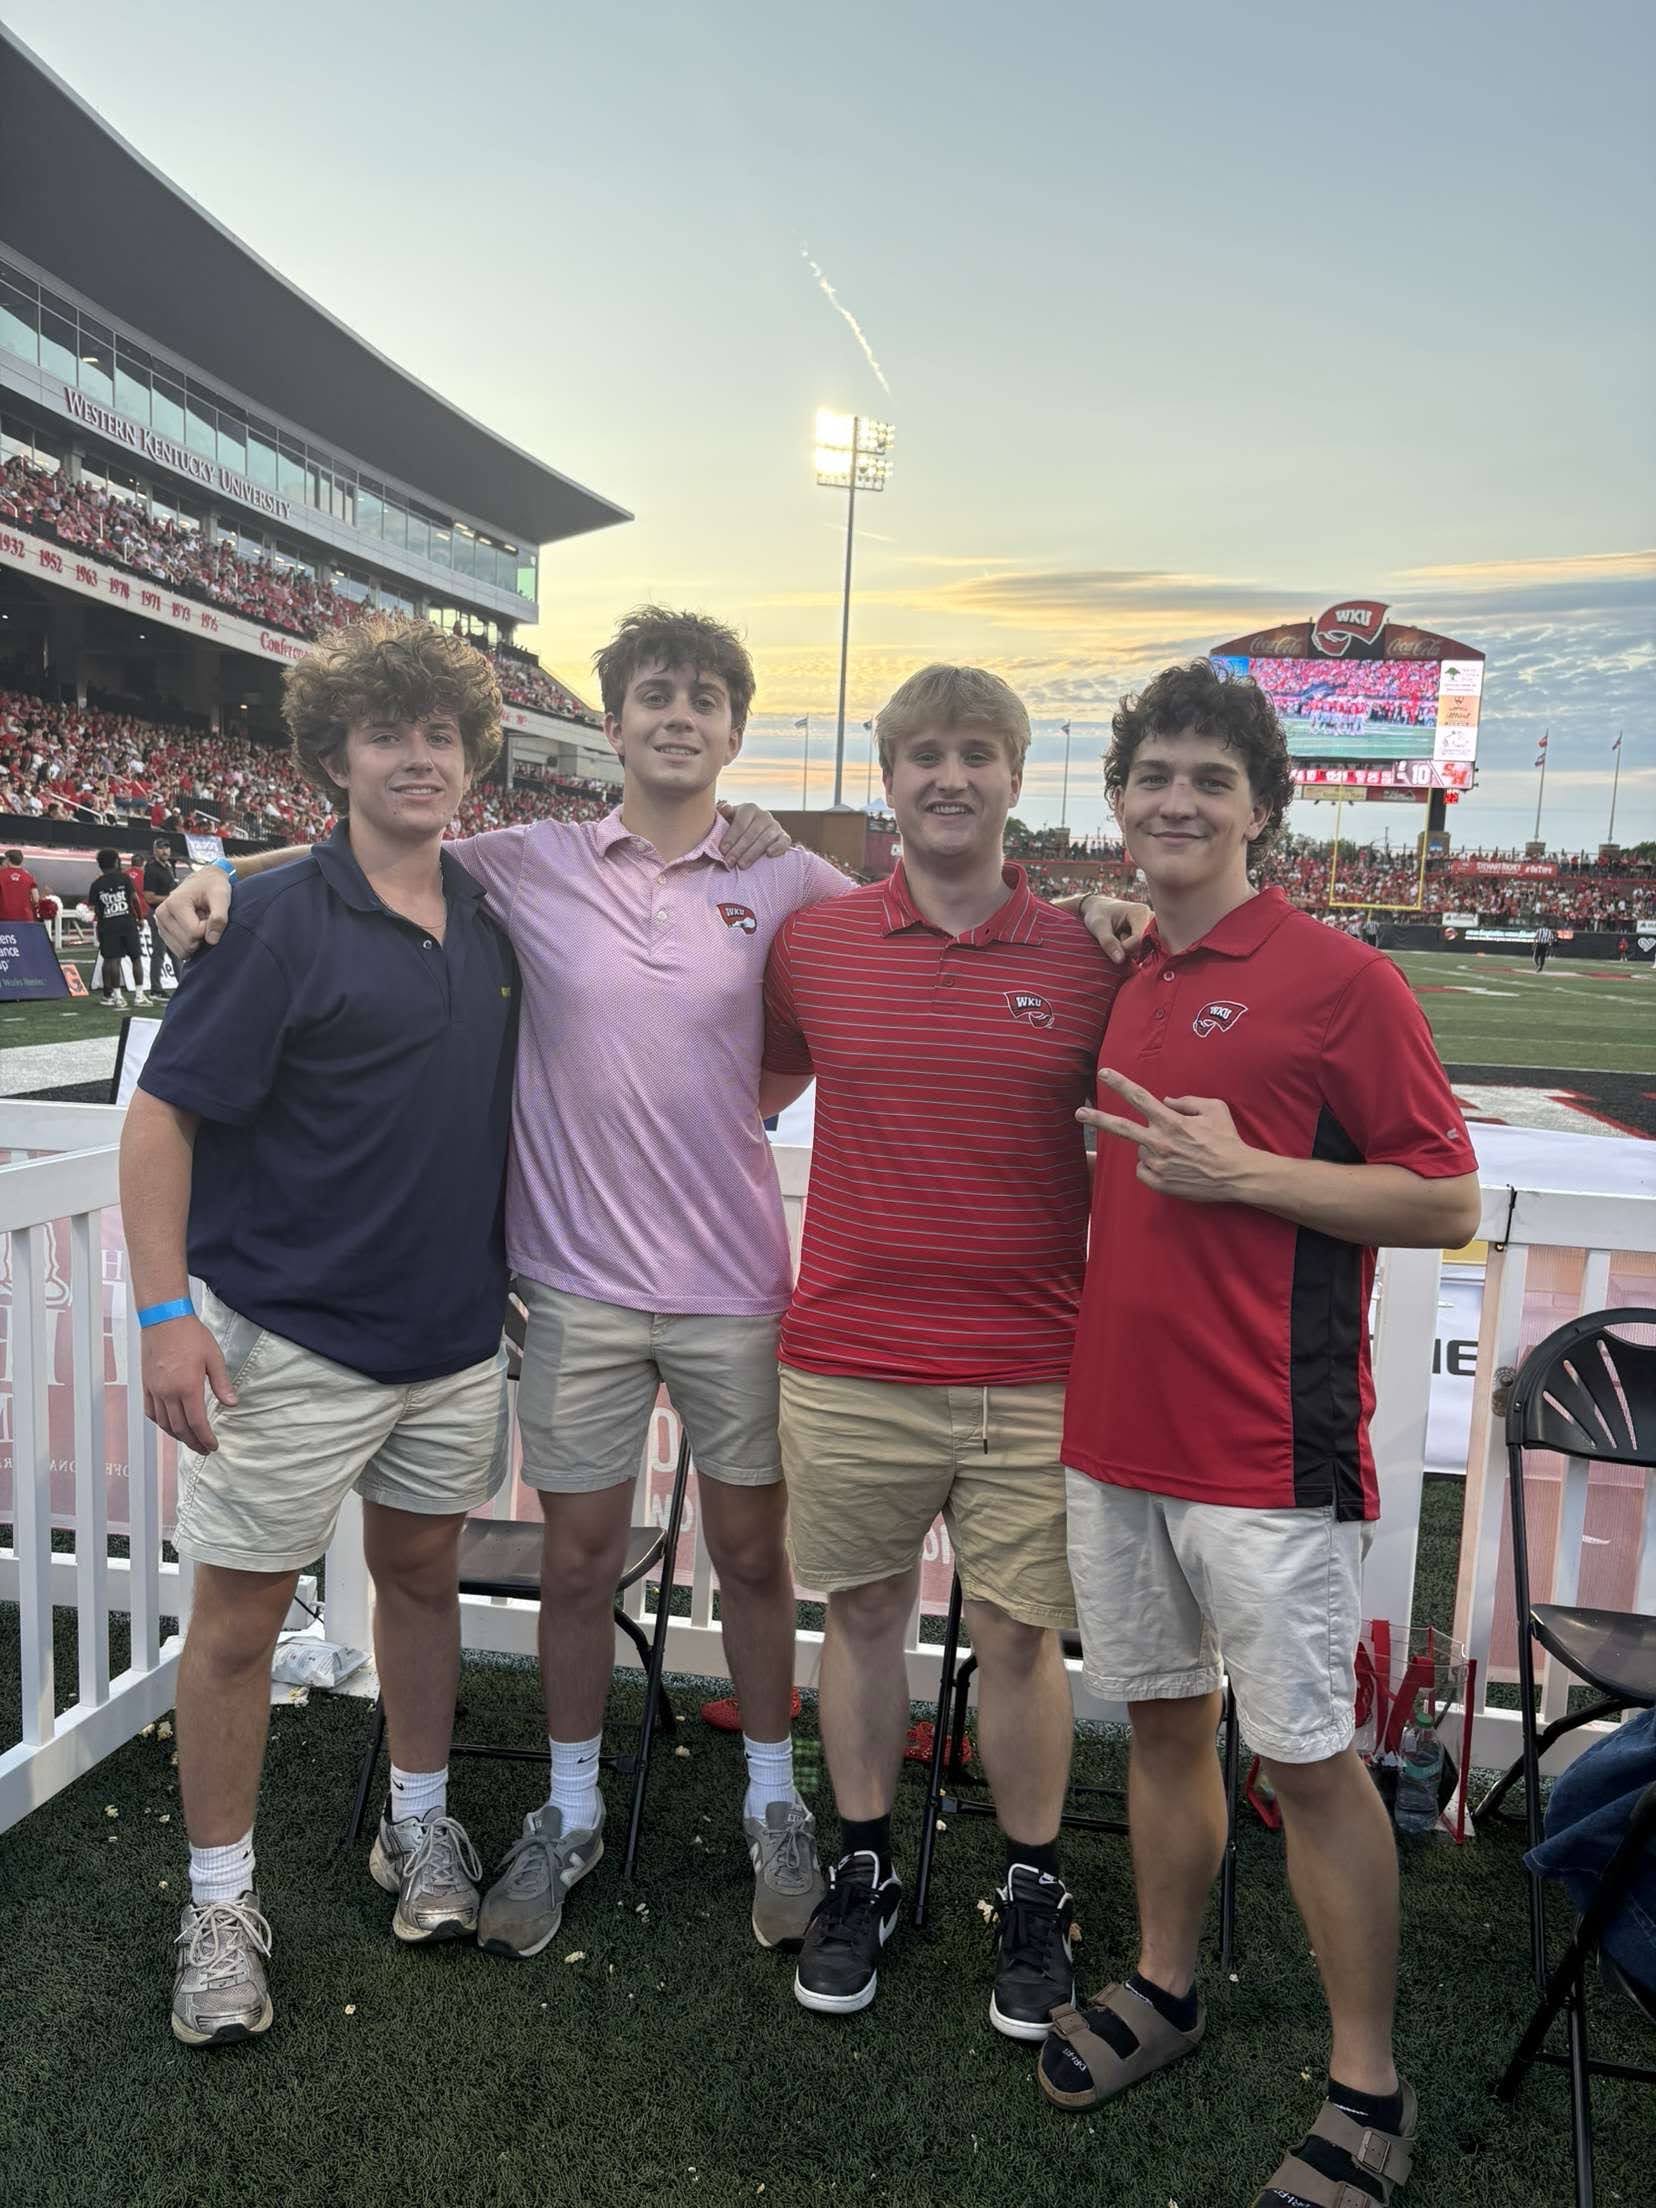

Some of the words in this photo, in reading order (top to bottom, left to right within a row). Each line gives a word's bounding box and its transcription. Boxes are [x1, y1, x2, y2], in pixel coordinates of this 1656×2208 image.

[64, 386, 136, 446] WESTERN
[140, 427, 215, 485] KENTUCKY
[219, 468, 292, 520] UNIVERSITY
[40, 549, 63, 574] 1952
[76, 564, 98, 587] 1963
[1335, 609, 1372, 627] WKU
[725, 907, 744, 916] WKU
[1016, 996, 1042, 1008] WKU
[1209, 1005, 1232, 1019] WKU
